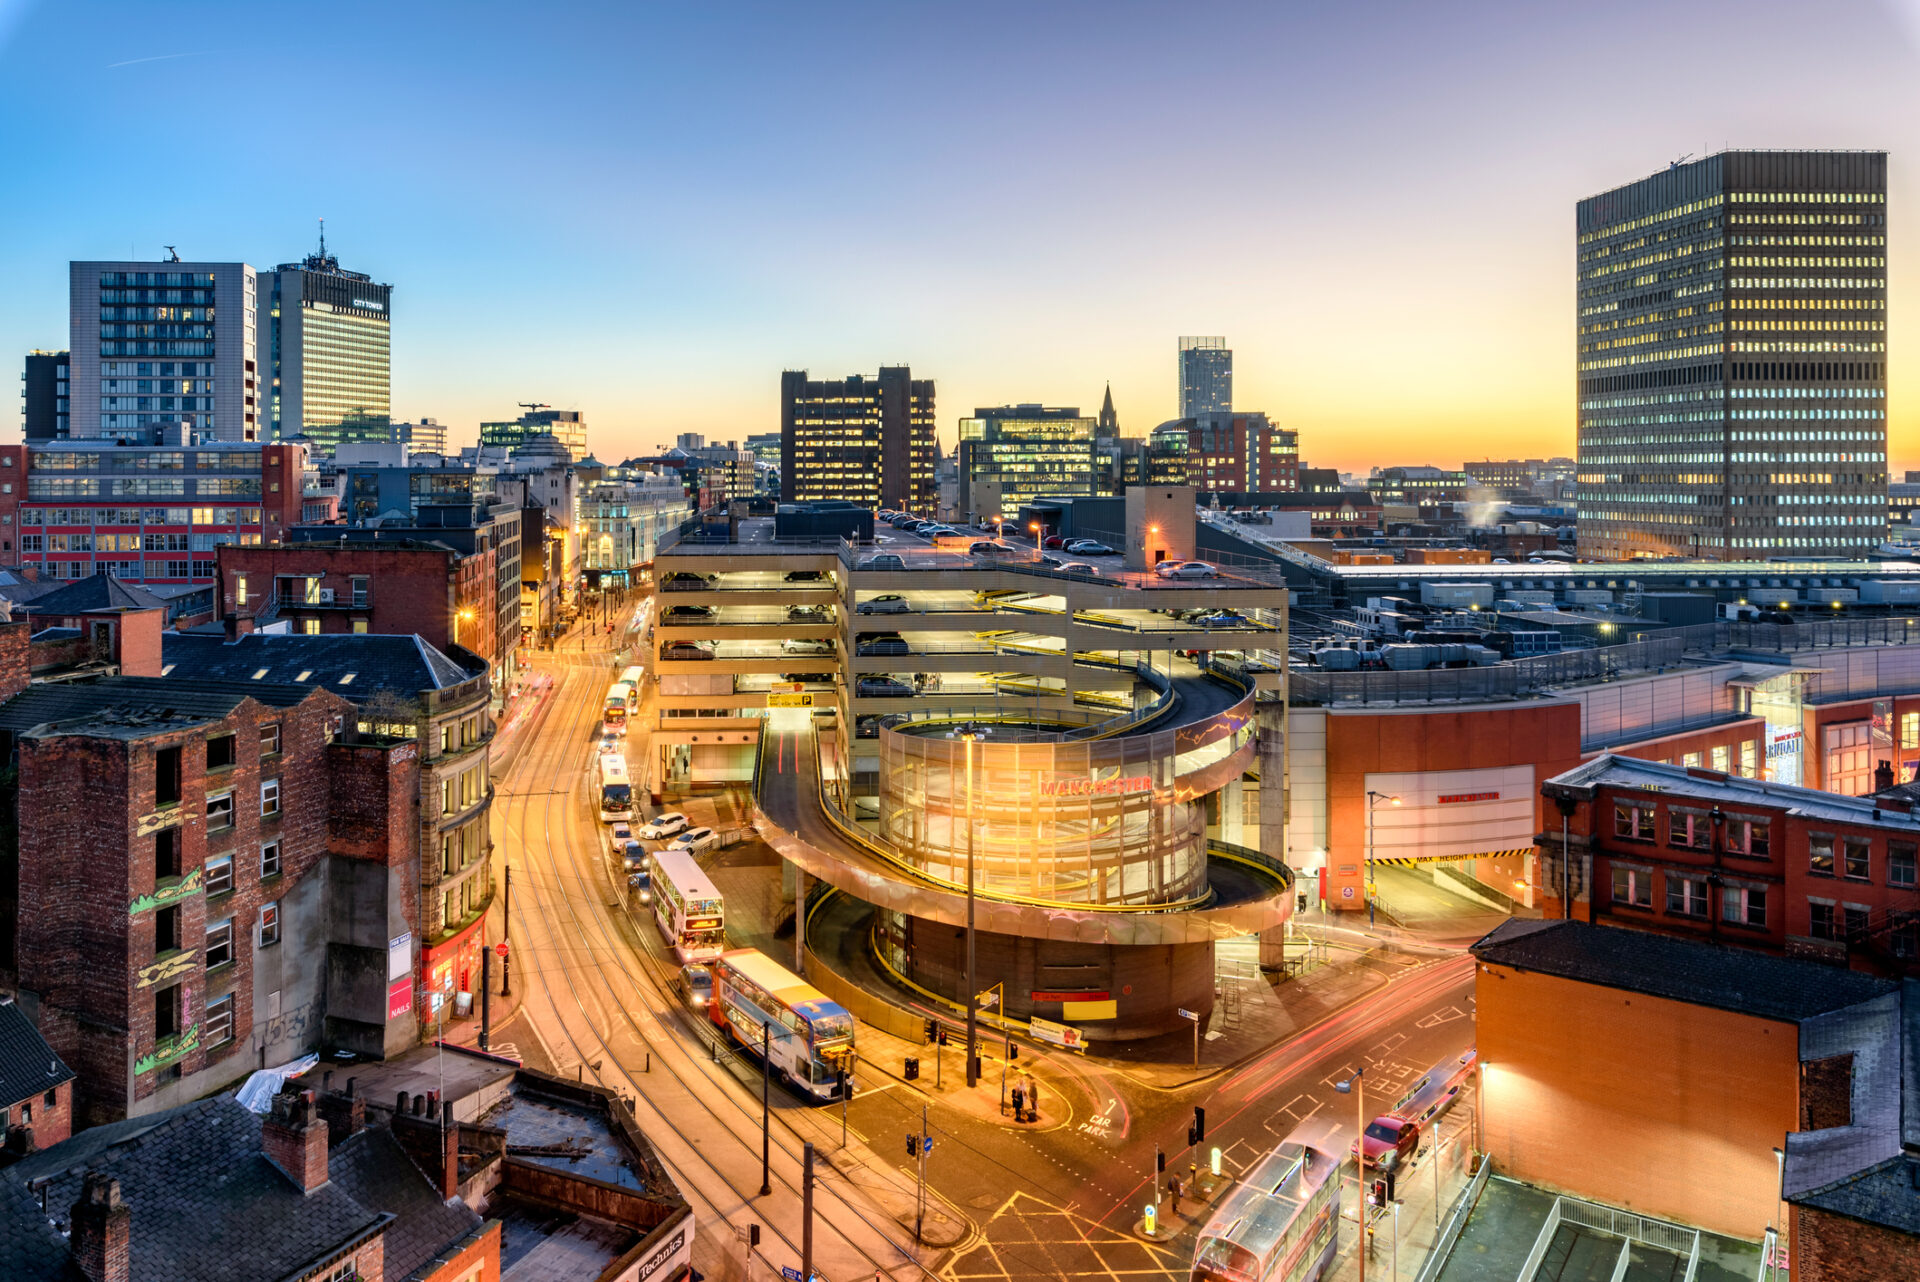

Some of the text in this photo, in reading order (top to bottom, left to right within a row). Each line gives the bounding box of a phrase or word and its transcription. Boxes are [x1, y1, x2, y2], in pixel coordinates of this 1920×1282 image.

[353, 299, 383, 310] CITY TOWER
[1040, 775, 1152, 796] MANCHESTER
[1439, 853, 1468, 862] HEIGHT
[391, 1002, 410, 1018] NAILS
[1090, 1114, 1111, 1127] CAR
[1078, 1122, 1112, 1139] PARK
[640, 1236, 683, 1280] Technics
